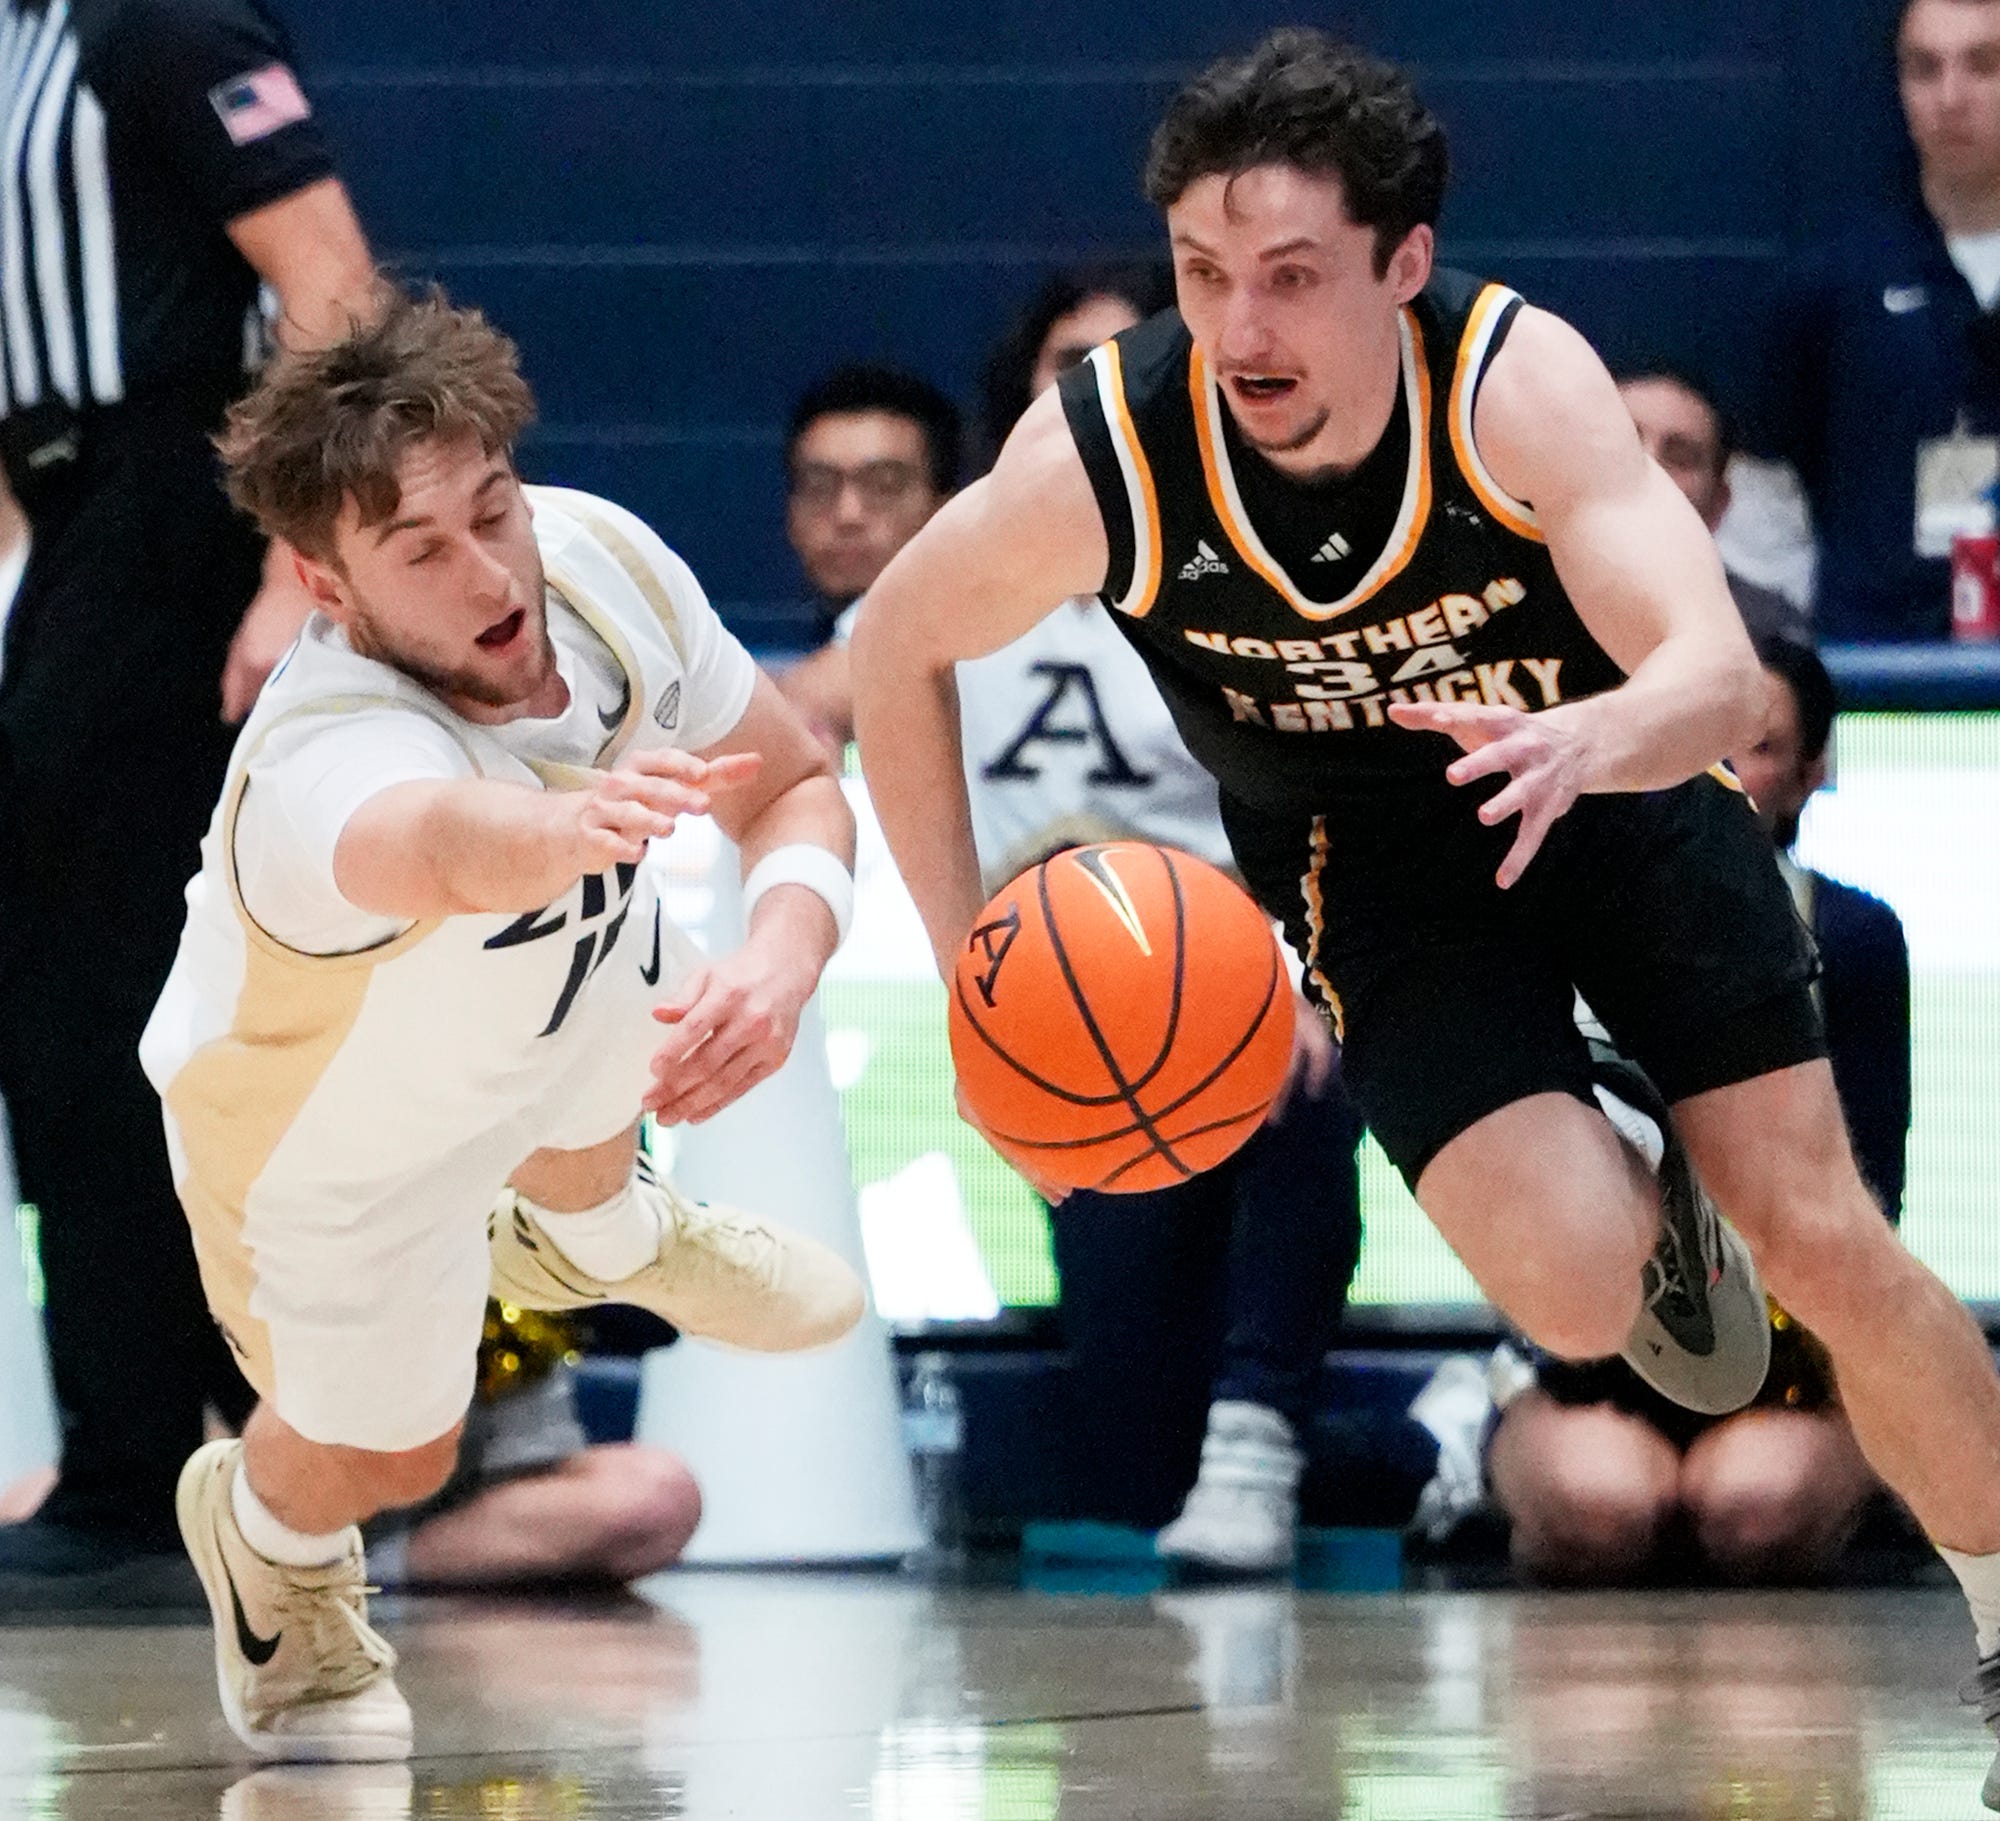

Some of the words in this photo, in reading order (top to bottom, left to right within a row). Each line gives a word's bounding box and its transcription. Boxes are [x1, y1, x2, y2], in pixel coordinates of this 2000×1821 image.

[1177, 559, 1230, 581] adidas
[1184, 576, 1528, 662] NORTHERN
[1285, 643, 1472, 700] 34
[981, 659, 1154, 786] A
